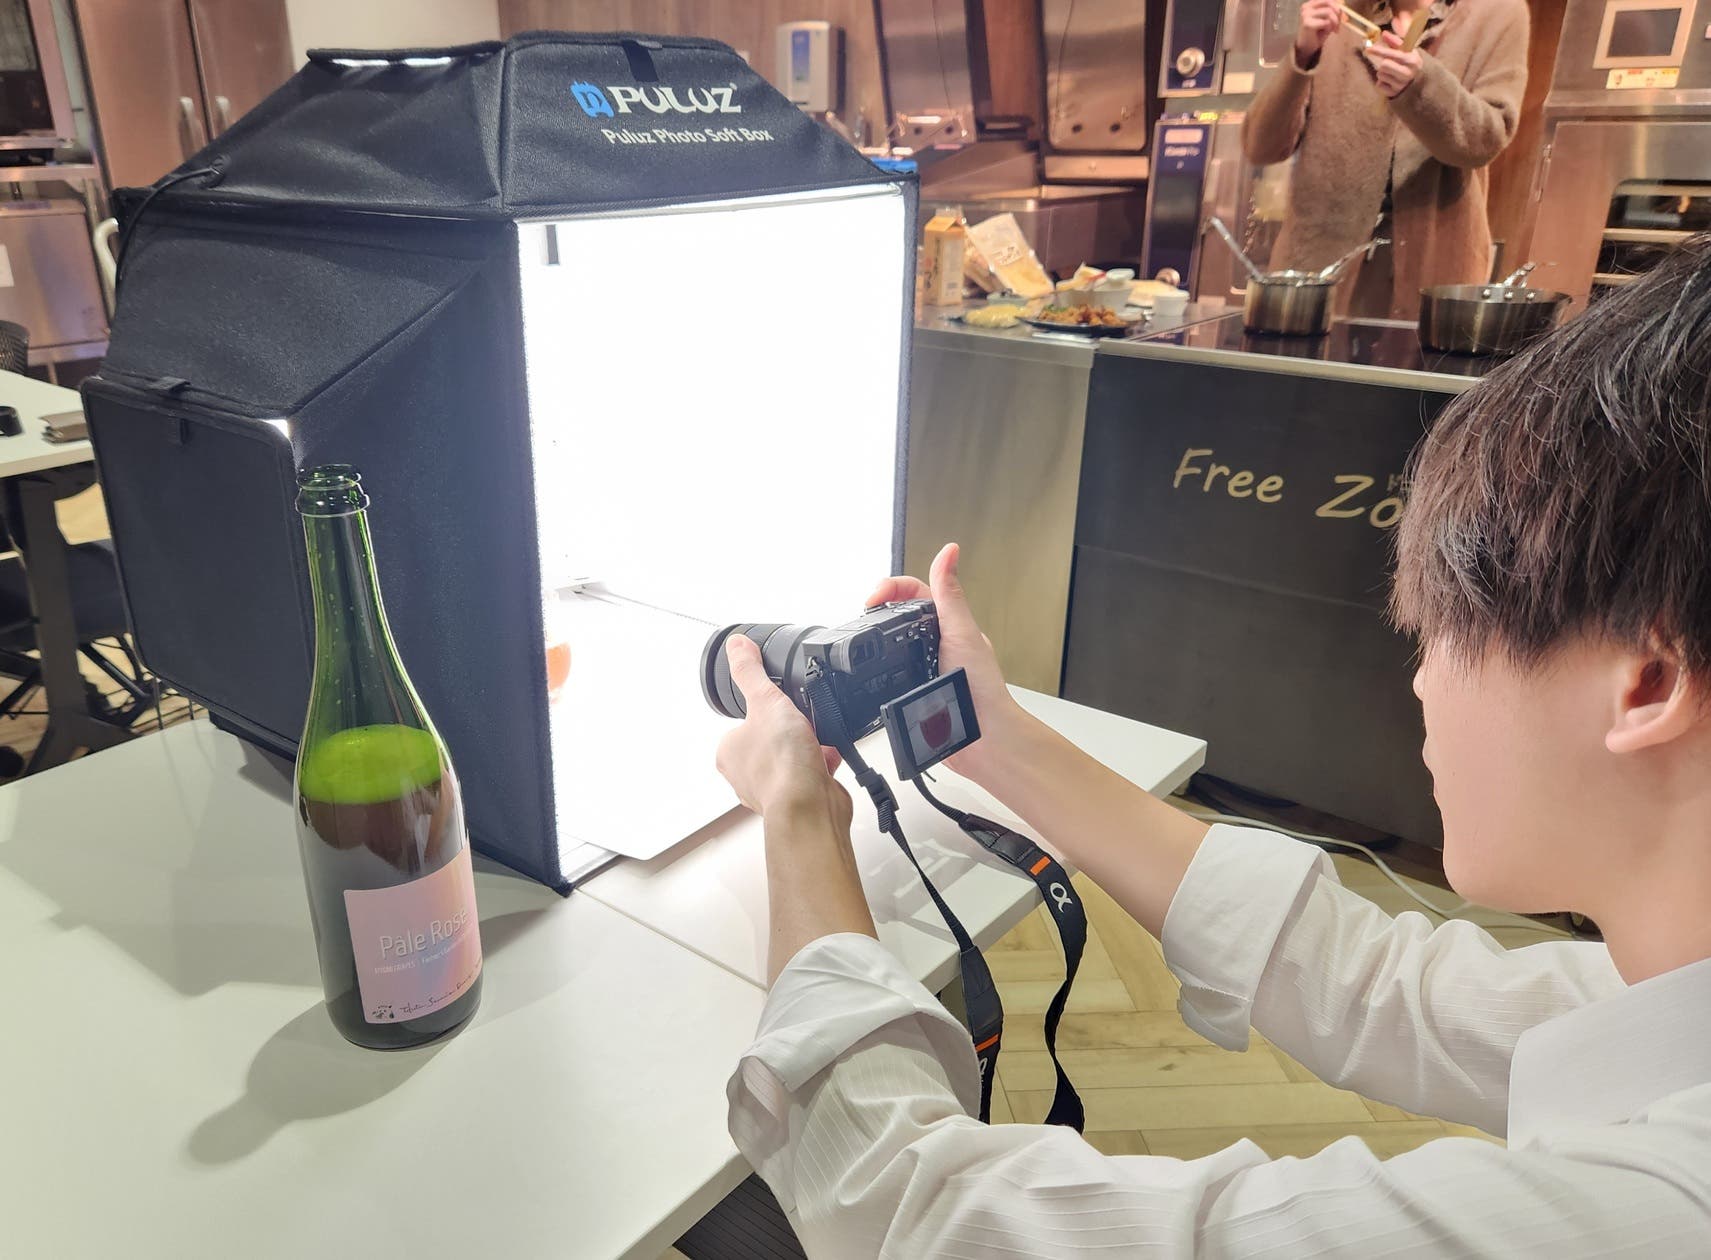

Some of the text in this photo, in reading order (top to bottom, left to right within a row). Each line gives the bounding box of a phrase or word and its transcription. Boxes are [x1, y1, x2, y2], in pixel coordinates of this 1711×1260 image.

[606, 85, 742, 114] PULUZ
[601, 127, 775, 144] Puluz Photo Soft Box
[1173, 448, 1404, 528] Free Zo
